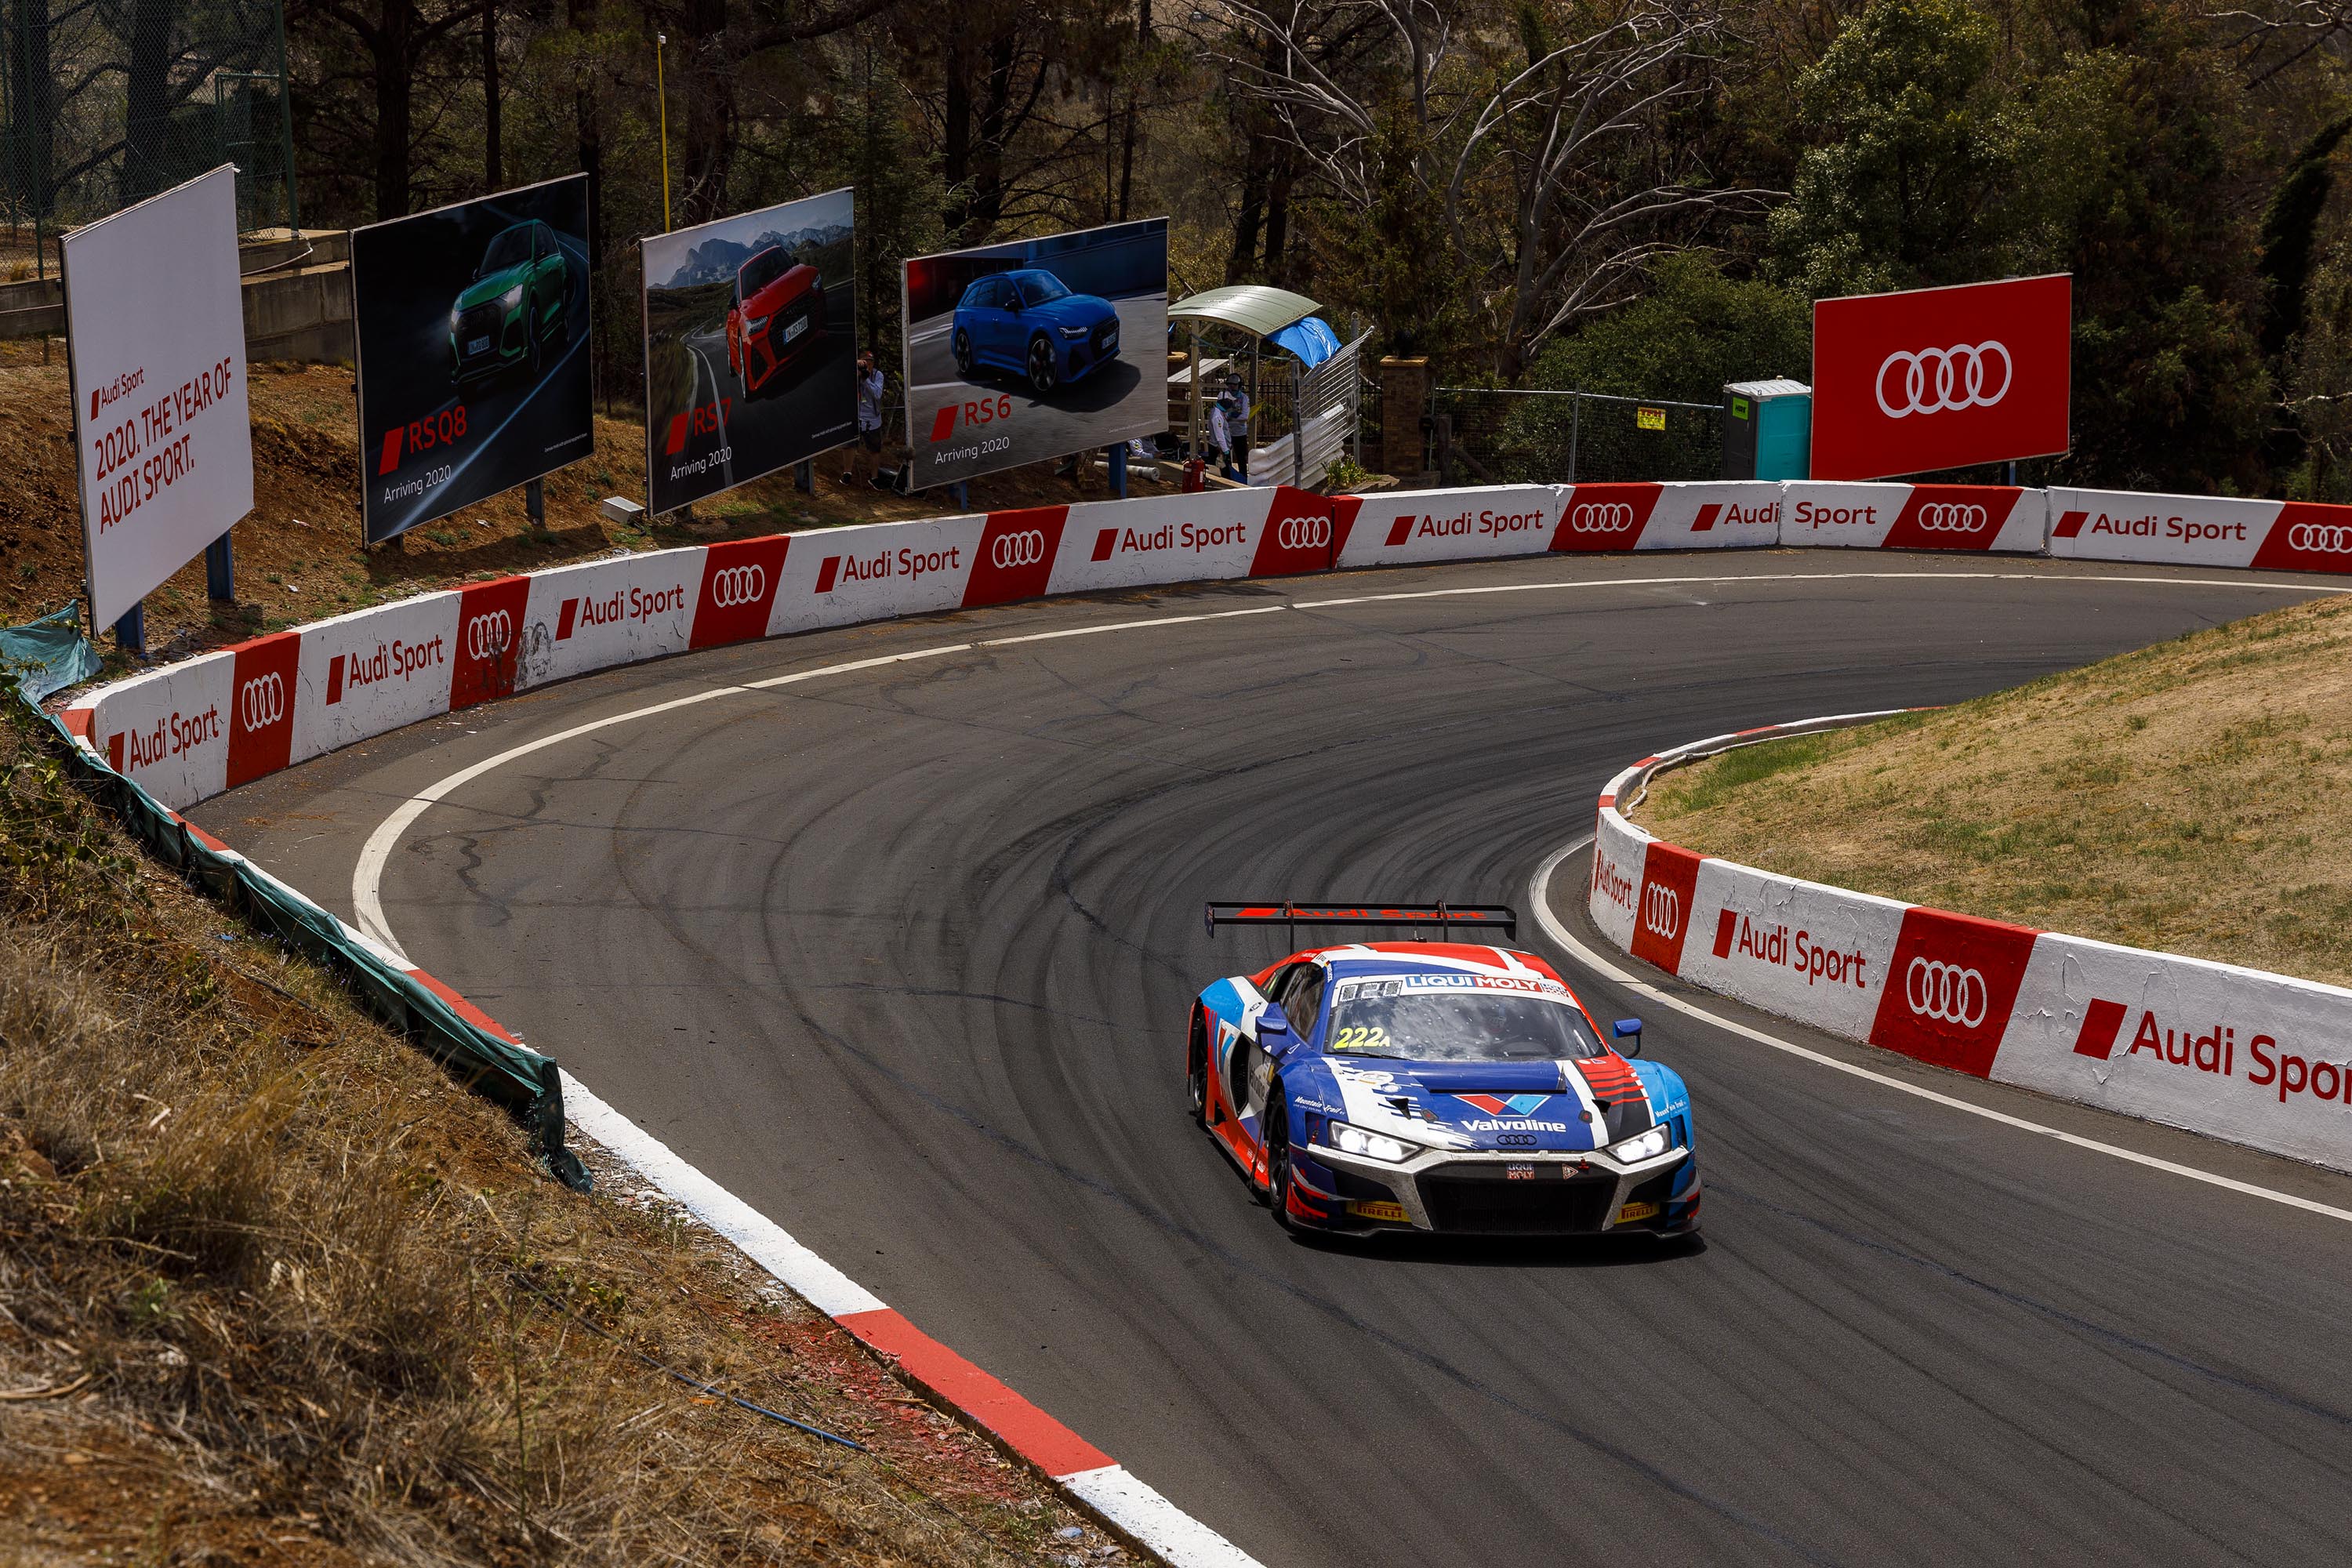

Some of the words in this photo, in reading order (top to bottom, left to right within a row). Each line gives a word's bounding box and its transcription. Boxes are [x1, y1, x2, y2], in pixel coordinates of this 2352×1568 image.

[101, 378, 120, 408] Audi
[122, 367, 144, 397] Sport
[95, 419, 140, 481] 2020.
[141, 395, 172, 447] THE
[173, 372, 212, 426] YEAR
[214, 357, 232, 400] OF
[670, 459, 706, 481] Arriving
[709, 446, 732, 468] 2020
[935, 445, 978, 465] Arriving
[981, 437, 1011, 455] 2020
[100, 468, 141, 535] AUDI
[143, 434, 195, 500] SPORT.
[383, 479, 424, 504] Arriving
[426, 464, 452, 489] 2020
[1417, 511, 1472, 538] Audi
[1478, 509, 1544, 539] Sport
[1723, 501, 1780, 525] Audi
[1794, 501, 1878, 529] Sport
[2091, 514, 2158, 537] Audi
[2165, 516, 2247, 544] Sport
[1120, 524, 1174, 553] Audi
[1180, 521, 1247, 553] Sport
[842, 550, 891, 583] Audi
[898, 546, 960, 582] Sport
[580, 590, 625, 627] Audi
[630, 583, 684, 624] Sport
[349, 643, 390, 690] Audi
[392, 634, 445, 682] Sport
[129, 717, 167, 772] Audi
[170, 703, 220, 762] Sport
[1610, 862, 1632, 910] Sport
[1287, 909, 1369, 918] Audi
[1737, 915, 1789, 967] Audi
[1793, 929, 1867, 989] Sport
[1408, 976, 1473, 988] LIQUI
[1475, 977, 1540, 991] MOLY
[2129, 1010, 2234, 1076] Audi
[1294, 1095, 1323, 1109] Mountain
[1324, 1104, 1341, 1113] Trail
[1460, 1119, 1567, 1133] Valvoline
[1508, 1171, 1534, 1179] MOLY
[1356, 1201, 1403, 1218] PIRELLI
[1621, 1204, 1653, 1220] PIRELLI
